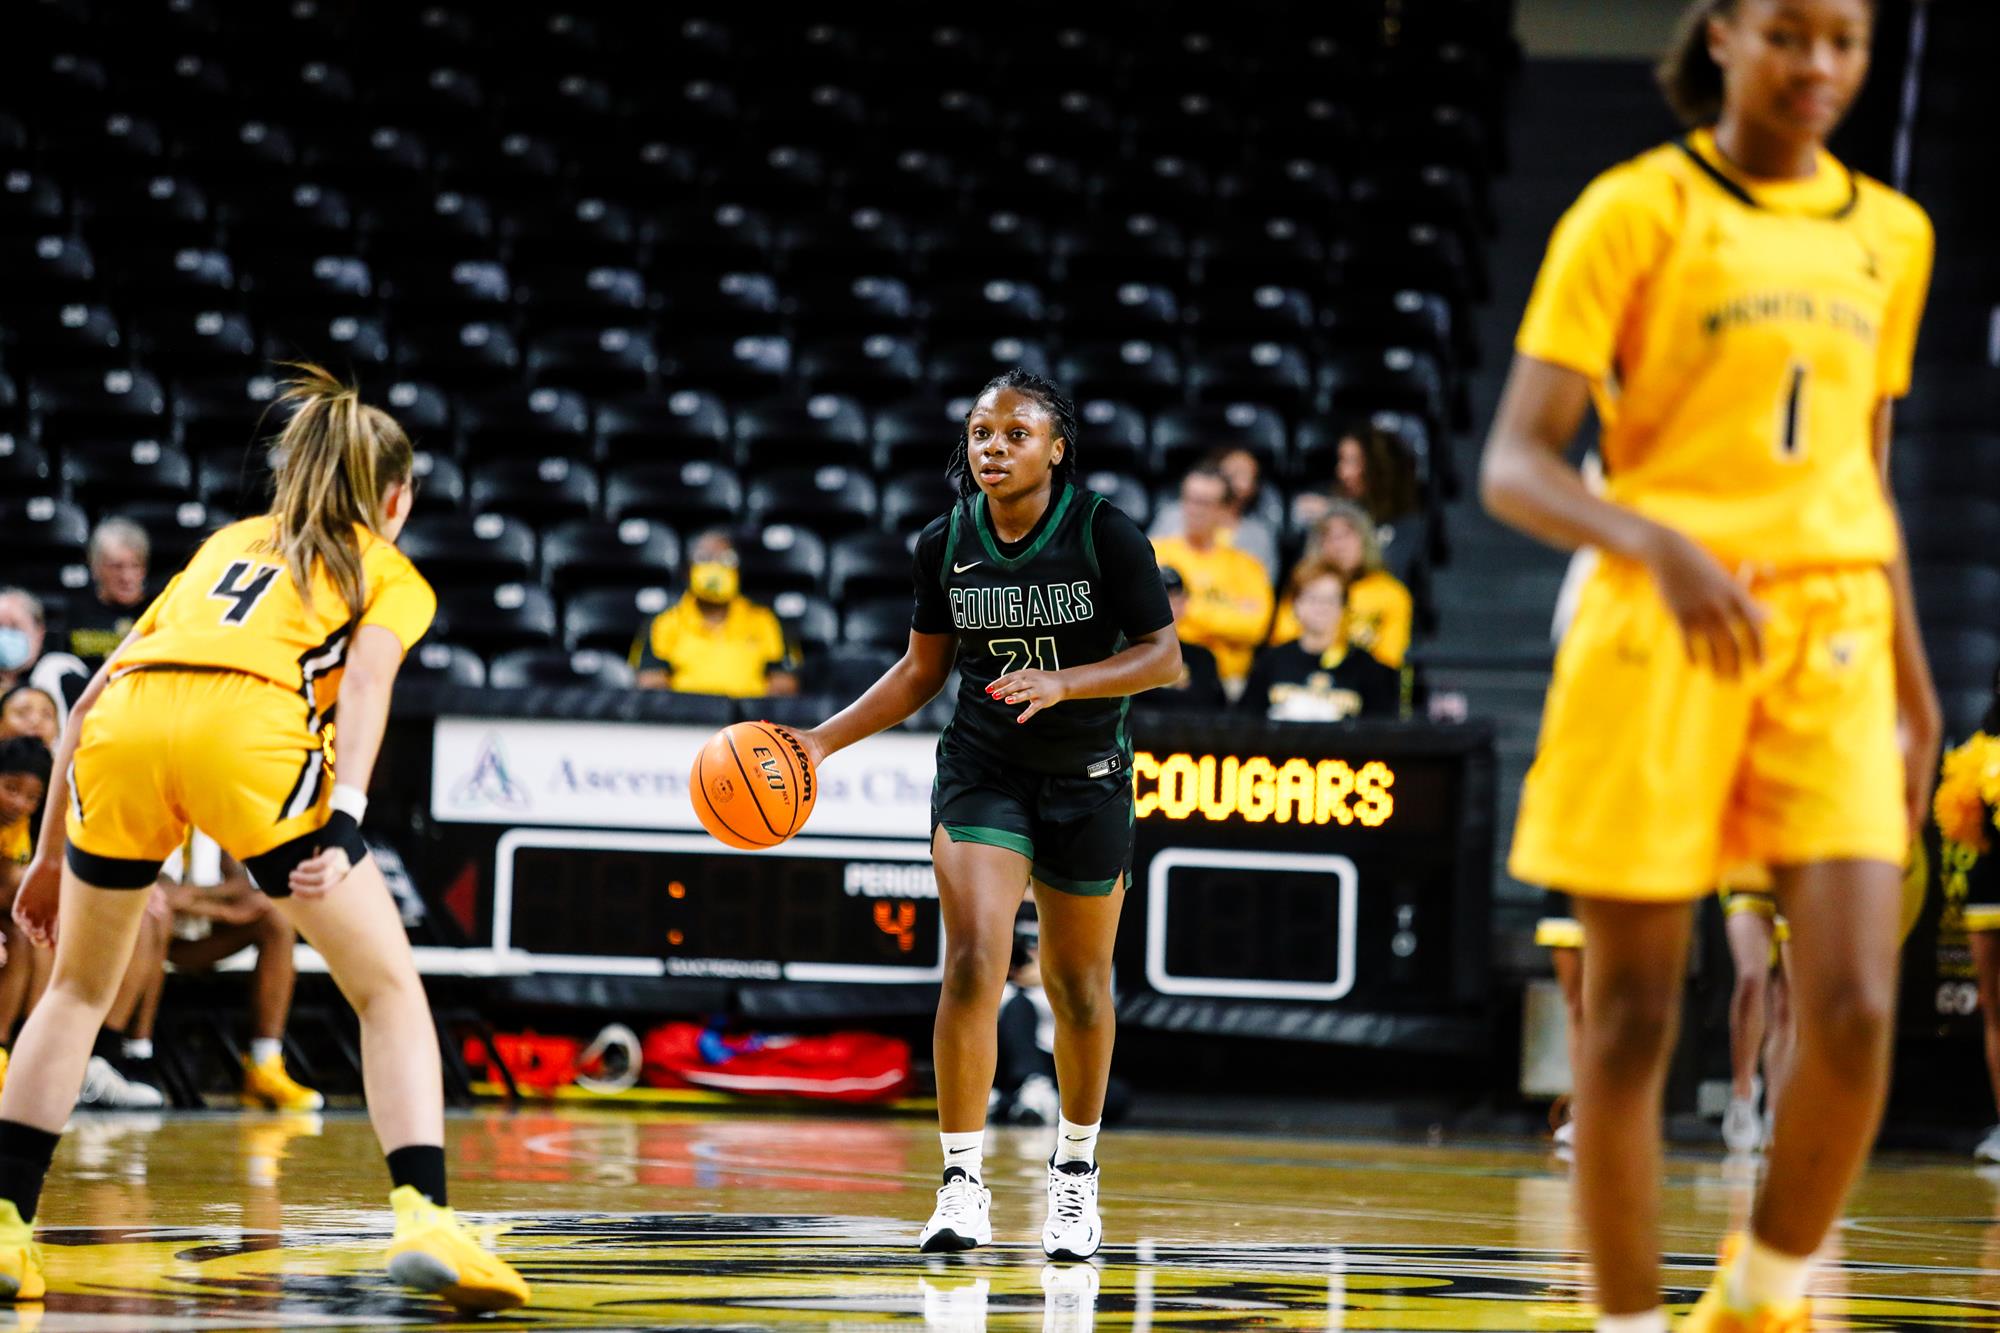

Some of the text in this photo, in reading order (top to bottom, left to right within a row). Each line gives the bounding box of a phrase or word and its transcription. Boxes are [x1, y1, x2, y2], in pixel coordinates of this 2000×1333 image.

[1773, 361, 1810, 462] 1
[207, 559, 287, 628] 4
[949, 580, 1094, 630] COUGARS
[988, 636, 1060, 678] 21
[1111, 760, 1117, 768] S
[1133, 752, 1395, 827] COUGARS
[873, 900, 917, 952] 4
